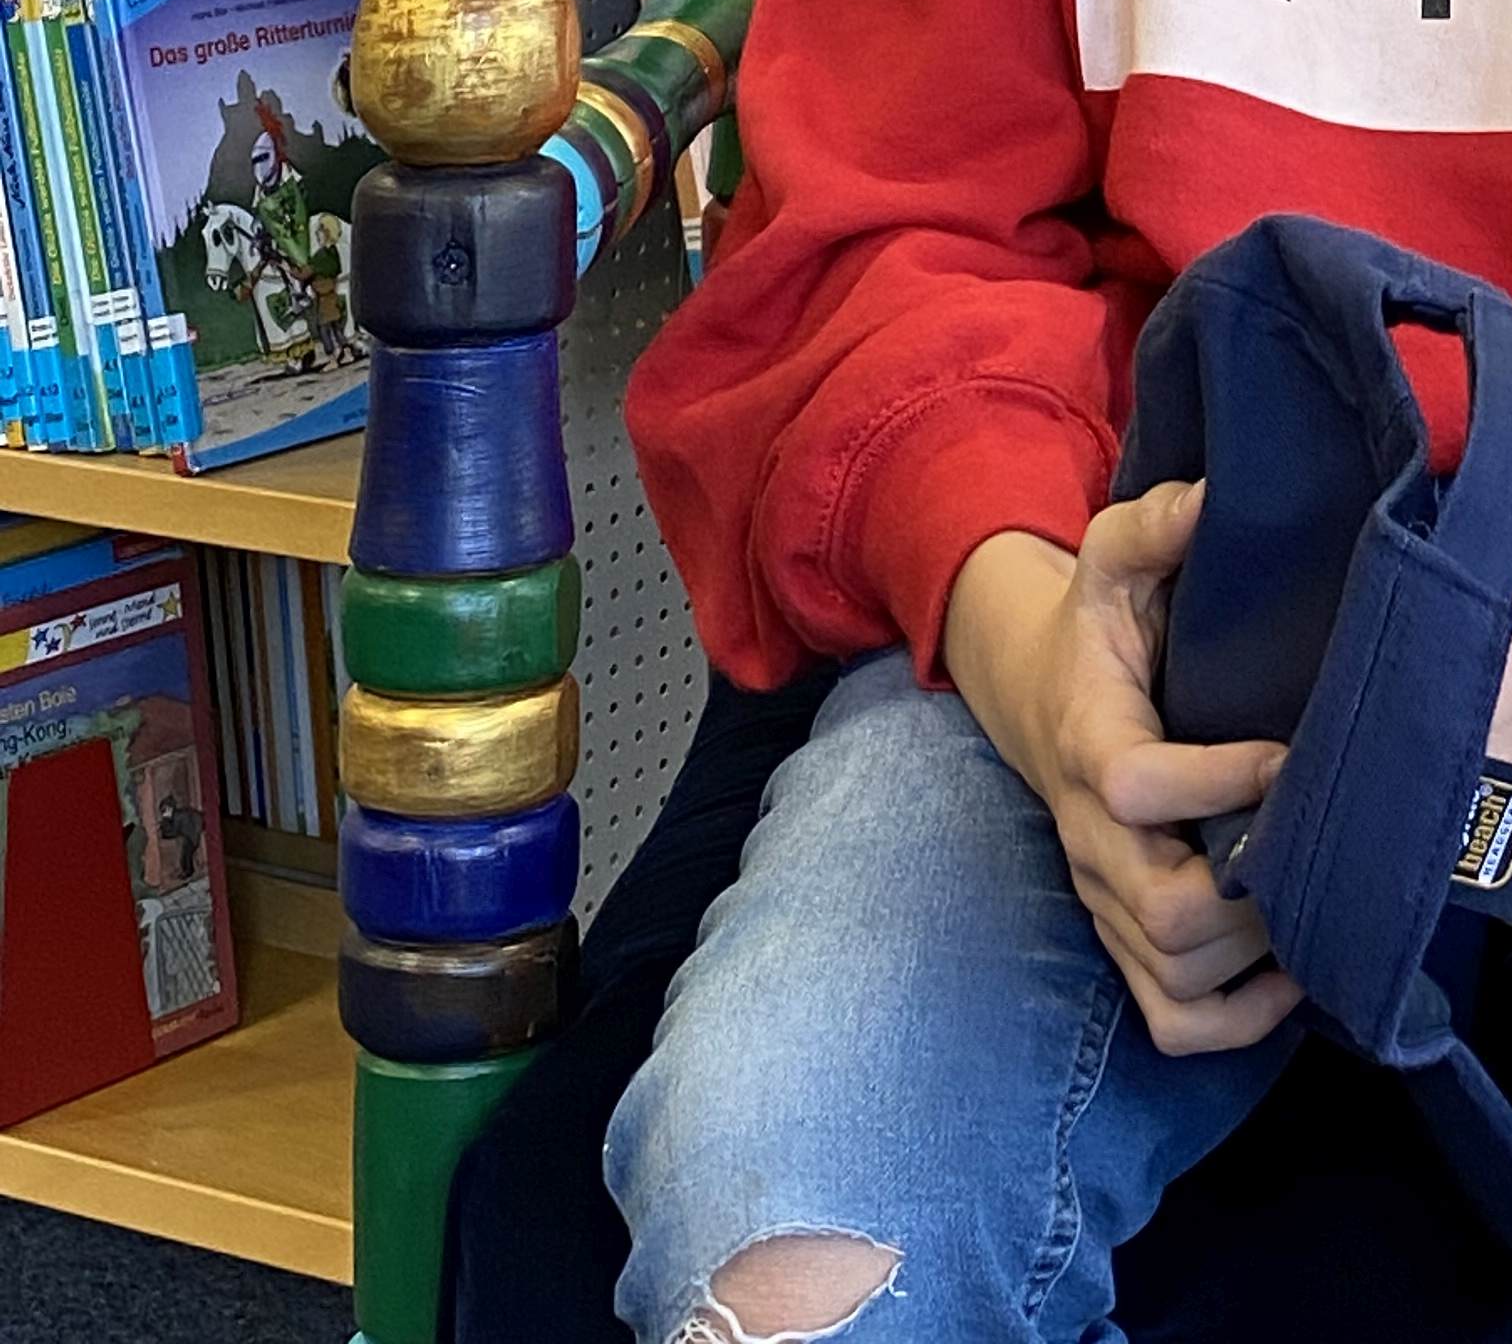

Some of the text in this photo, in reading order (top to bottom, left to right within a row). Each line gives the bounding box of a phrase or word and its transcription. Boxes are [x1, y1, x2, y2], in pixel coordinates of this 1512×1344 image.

[149, 45, 188, 68] Das
[194, 31, 251, 65] große
[39, 685, 77, 710] Boie
